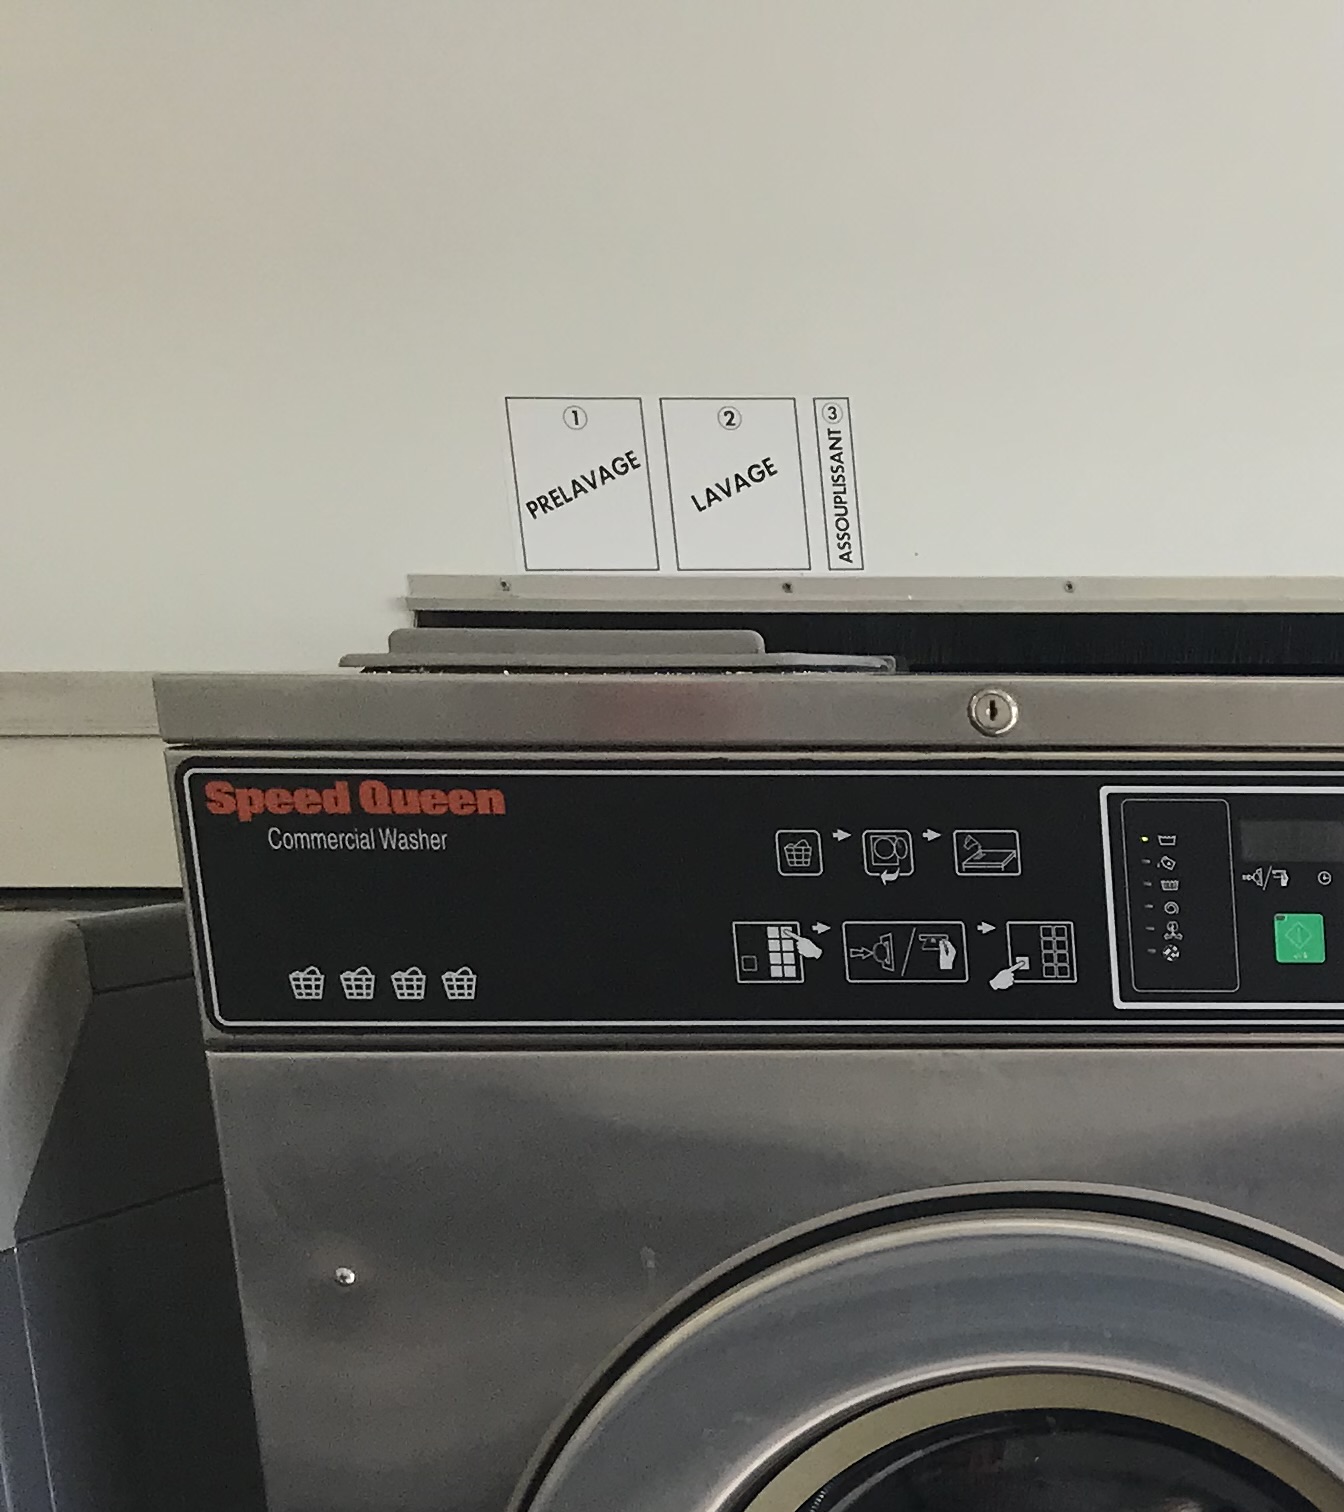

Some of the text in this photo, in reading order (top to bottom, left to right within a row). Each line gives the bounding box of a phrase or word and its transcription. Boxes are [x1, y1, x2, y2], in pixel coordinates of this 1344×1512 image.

[525, 450, 641, 519] PRELAVAGE
[691, 457, 778, 512] LAVAGE
[826, 428, 853, 563] ASSOUPLISSANT
[204, 779, 506, 822] Speed Queen
[268, 828, 448, 850] Commercial Washer
